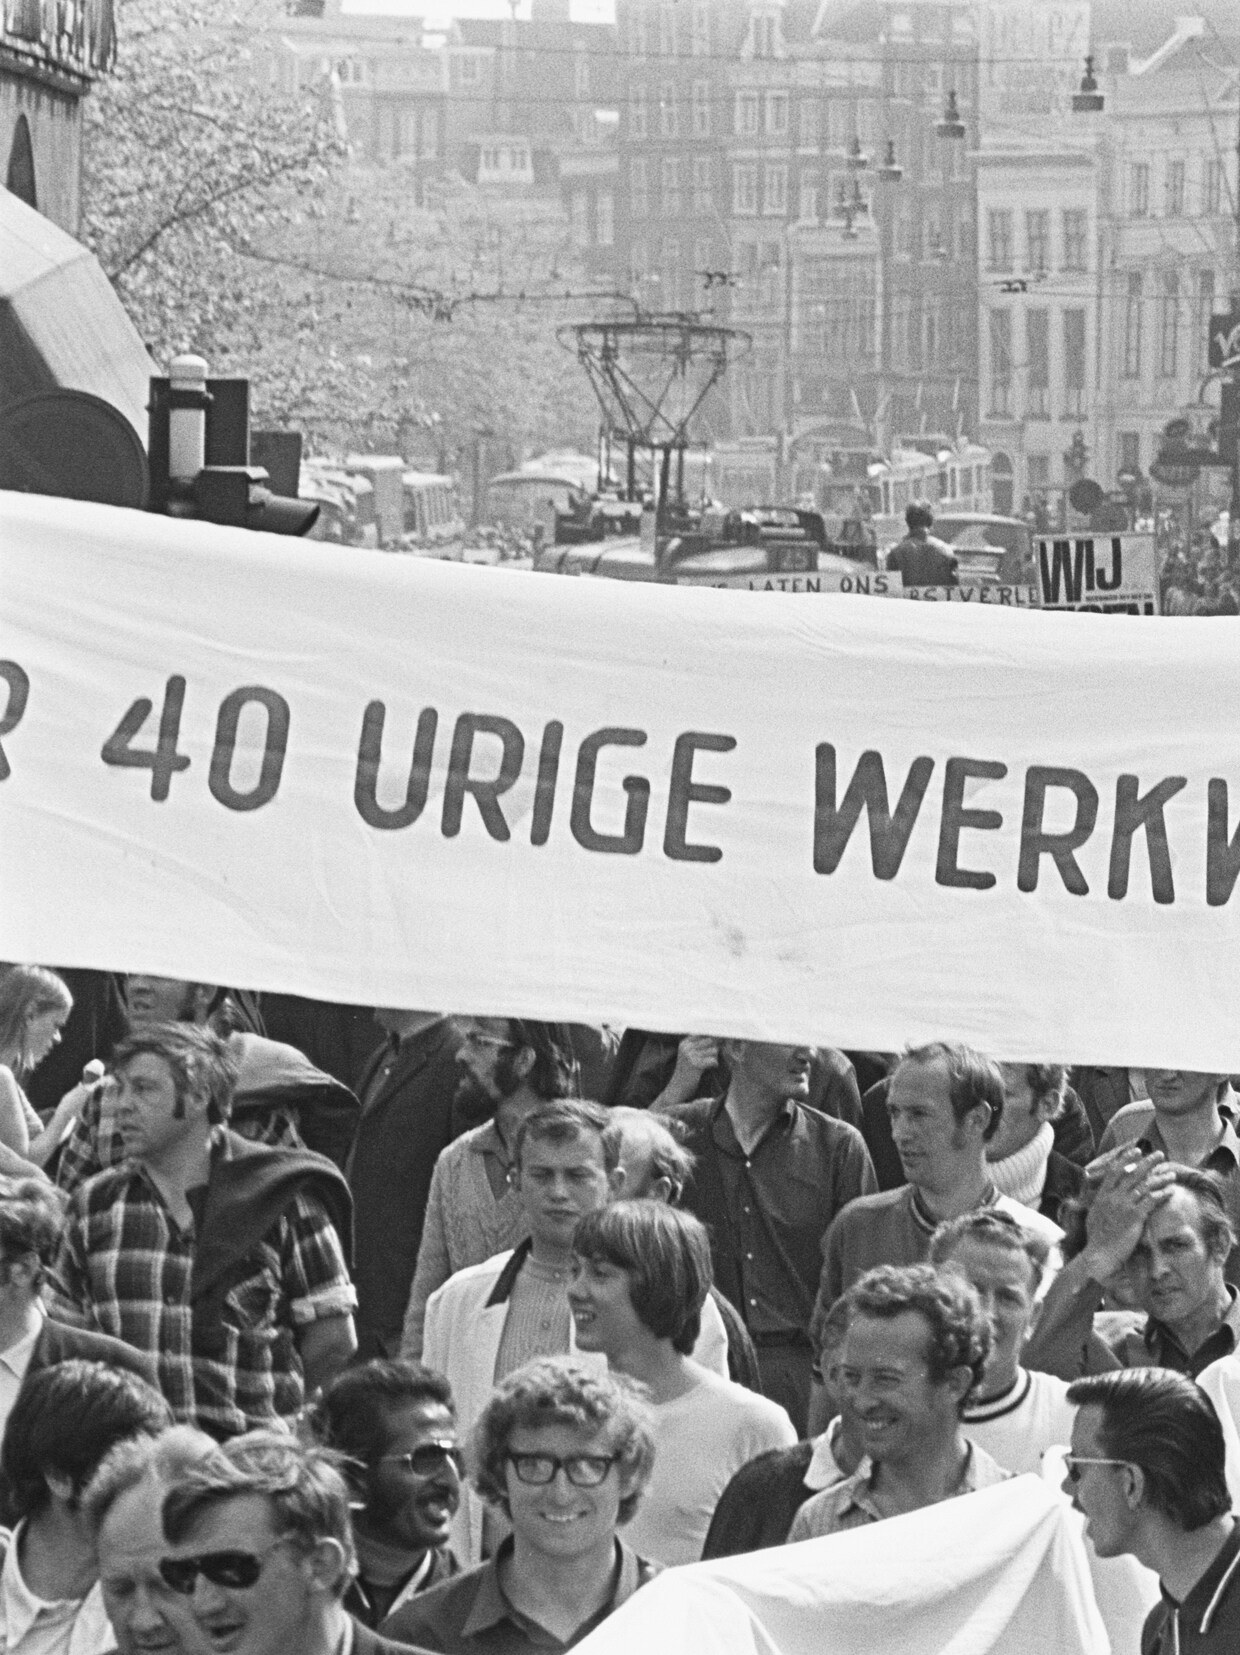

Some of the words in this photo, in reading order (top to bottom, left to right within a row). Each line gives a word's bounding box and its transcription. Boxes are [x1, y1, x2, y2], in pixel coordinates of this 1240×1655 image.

[839, 574, 888, 595] ONS
[1039, 536, 1122, 604] WIJ
[101, 674, 290, 811] 40
[354, 700, 737, 863] URIGE
